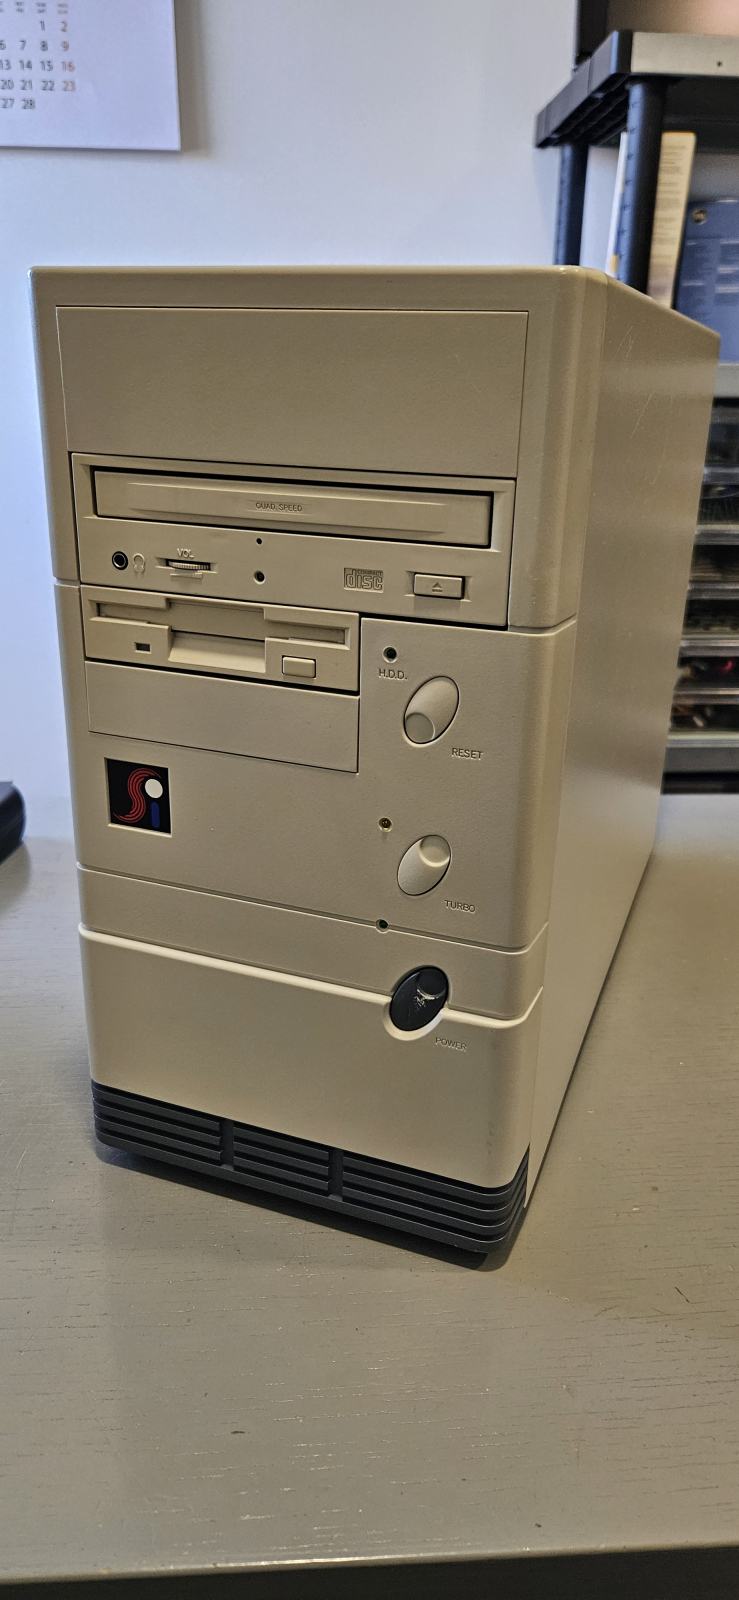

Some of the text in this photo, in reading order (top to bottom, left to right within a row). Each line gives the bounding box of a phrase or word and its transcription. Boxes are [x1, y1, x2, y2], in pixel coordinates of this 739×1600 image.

[40, 20, 68, 33] 1 2
[19, 40, 27, 51] 7
[40, 40, 49, 52] 8
[61, 40, 70, 52] 9
[19, 60, 33, 71] 14
[40, 60, 54, 72] 15
[61, 61, 76, 73] 16
[0, 80, 76, 92] 20 21 22 23
[0, 98, 36, 110] 27 28
[278, 503, 303, 512] SPEED
[176, 547, 195, 559] VOL
[378, 668, 408, 680] H.D.D.
[451, 747, 483, 760] RESET
[444, 899, 476, 913] TURBO
[435, 1036, 467, 1051] POWER
